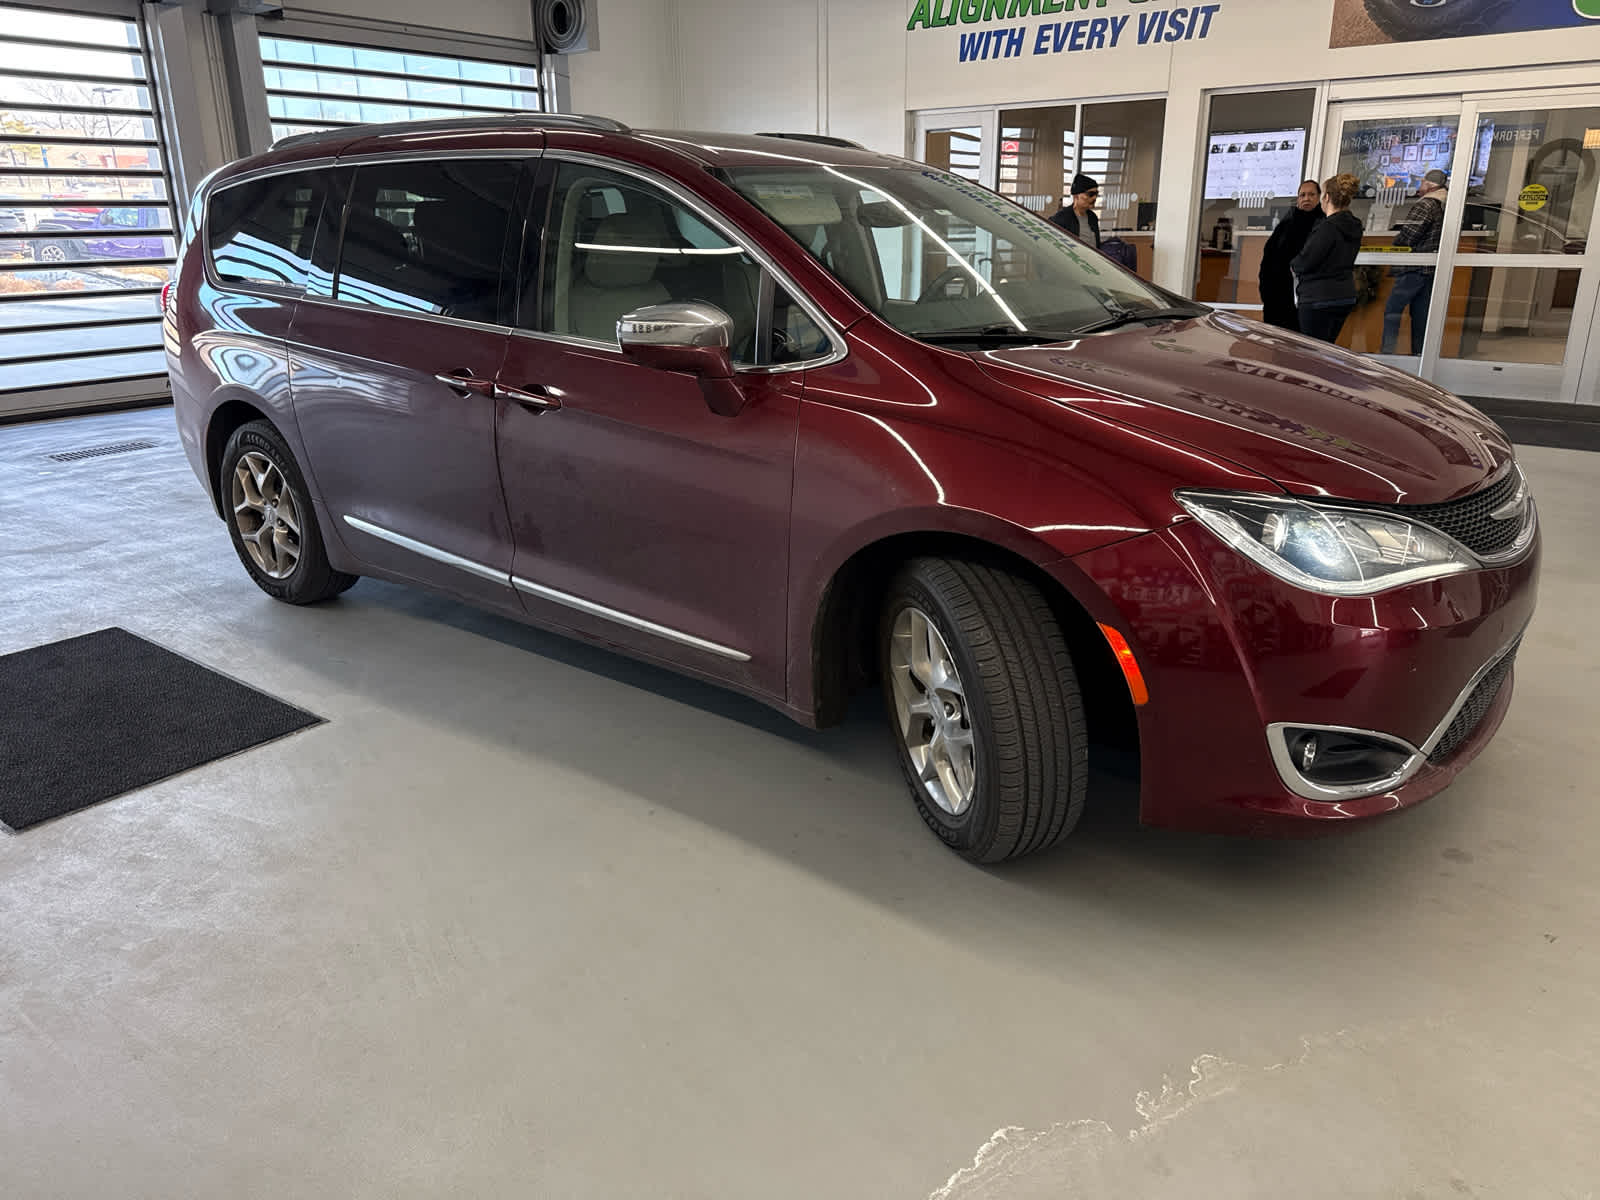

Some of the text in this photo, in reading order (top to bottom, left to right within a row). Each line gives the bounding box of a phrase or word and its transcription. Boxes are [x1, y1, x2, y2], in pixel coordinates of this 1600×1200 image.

[907, 0, 1107, 30] ALIGN
[959, 4, 1221, 63] WITH EVERY VISIT
